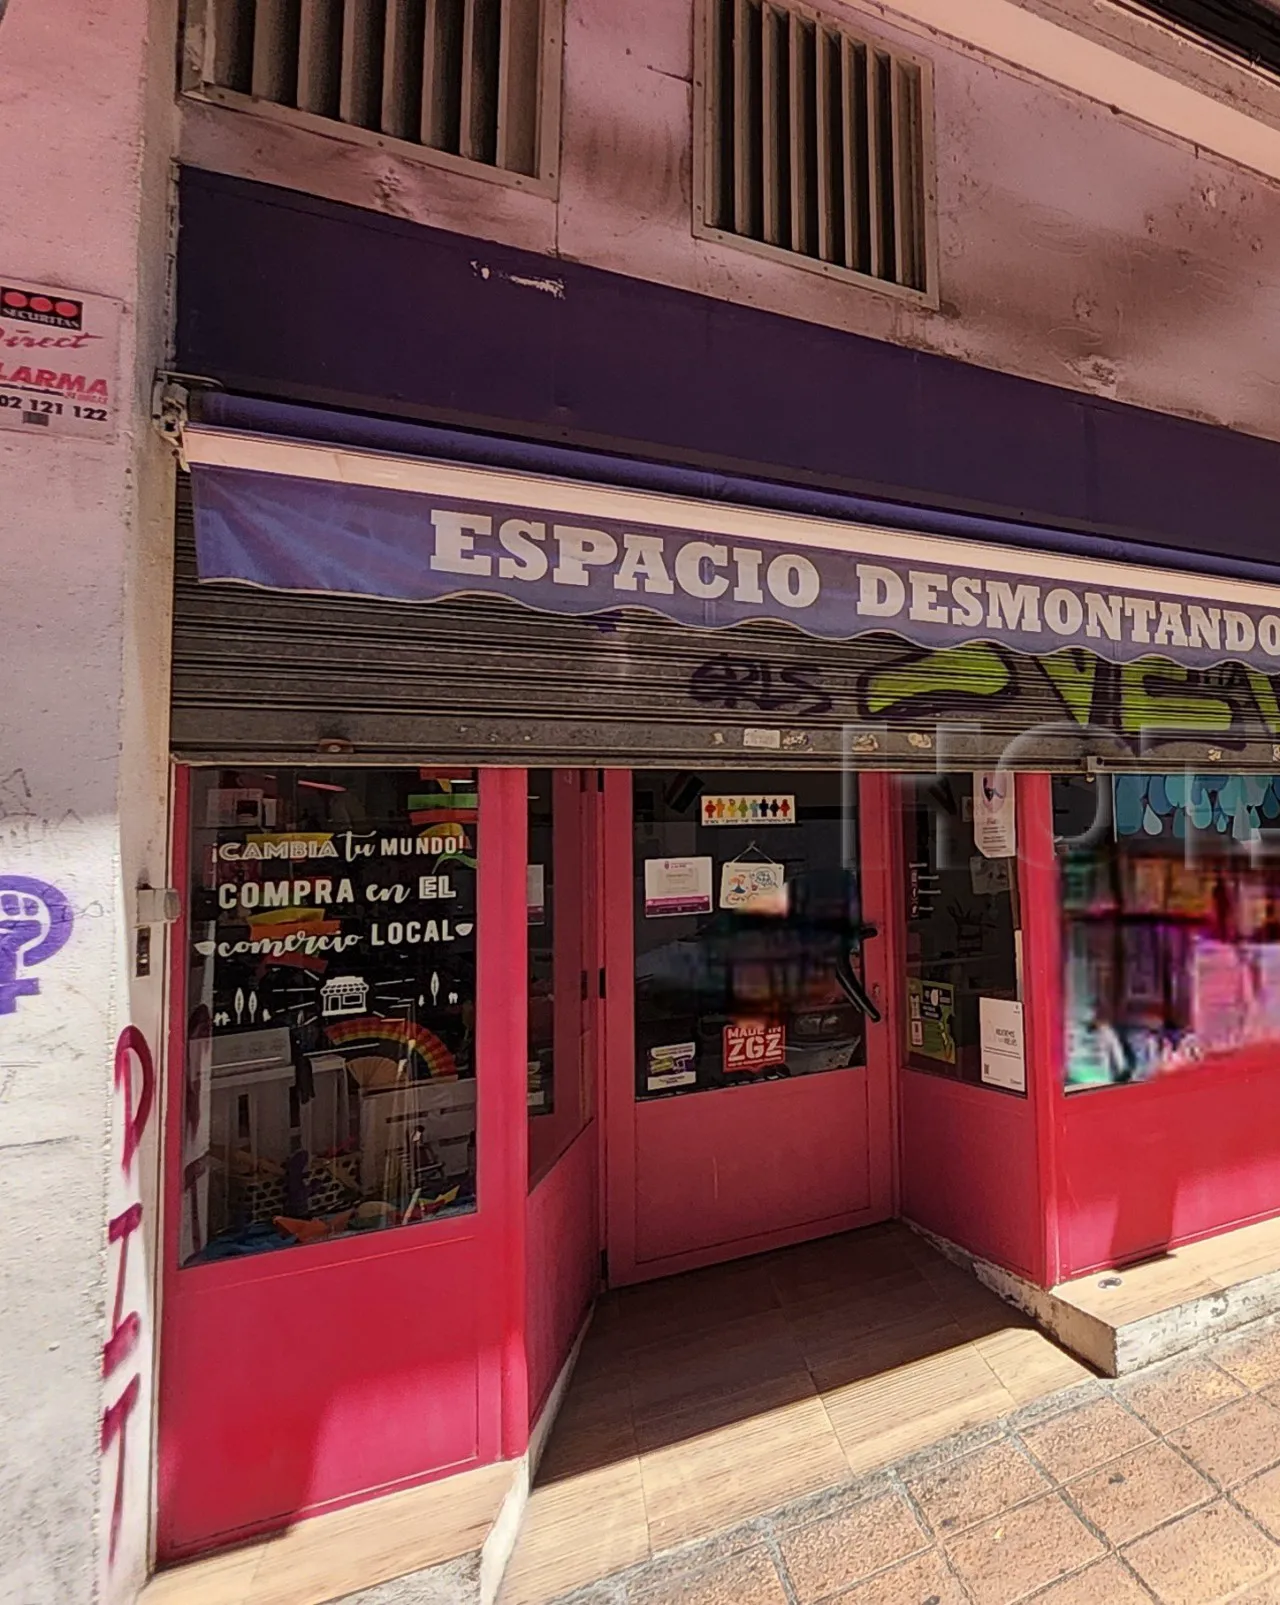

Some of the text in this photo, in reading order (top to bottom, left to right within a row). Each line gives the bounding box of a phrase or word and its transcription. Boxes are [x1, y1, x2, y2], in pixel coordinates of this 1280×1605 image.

[2, 307, 81, 328] SECURITAS
[29, 398, 63, 415] 121
[73, 405, 107, 421] 122
[430, 509, 820, 608] ESPACIO
[338, 831, 376, 861] tu
[218, 876, 457, 909] COMPRA en EL
[217, 920, 455, 957] comercio LOCAL
[728, 1034, 782, 1061] ZGZ
